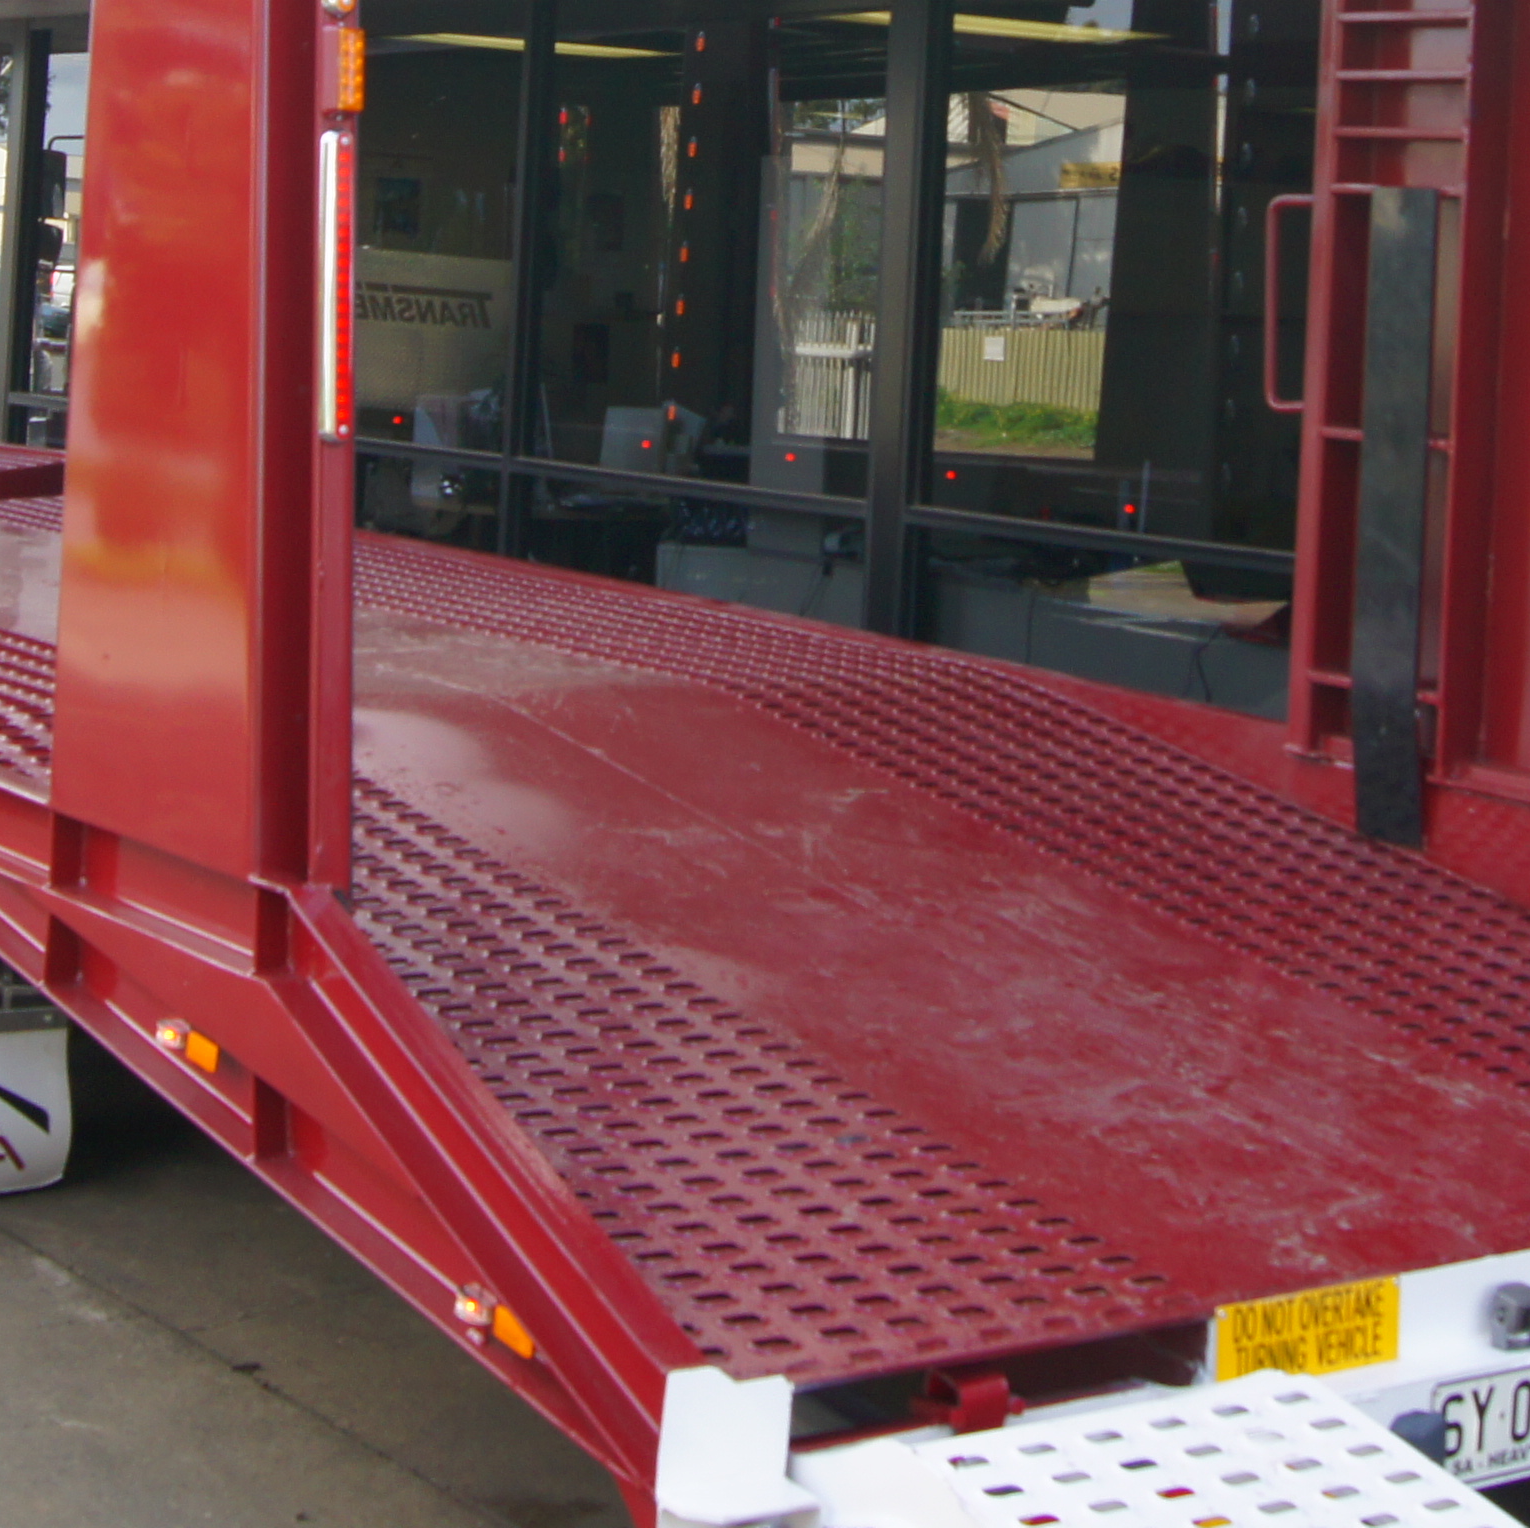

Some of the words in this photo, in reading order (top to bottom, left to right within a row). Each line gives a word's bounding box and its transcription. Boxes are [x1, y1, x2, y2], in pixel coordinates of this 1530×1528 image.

[1233, 1306, 1259, 1344] DO
[1263, 1298, 1294, 1339] NOT
[1298, 1281, 1383, 1331] OVERTAKE
[1315, 1322, 1382, 1366] VEHICLE
